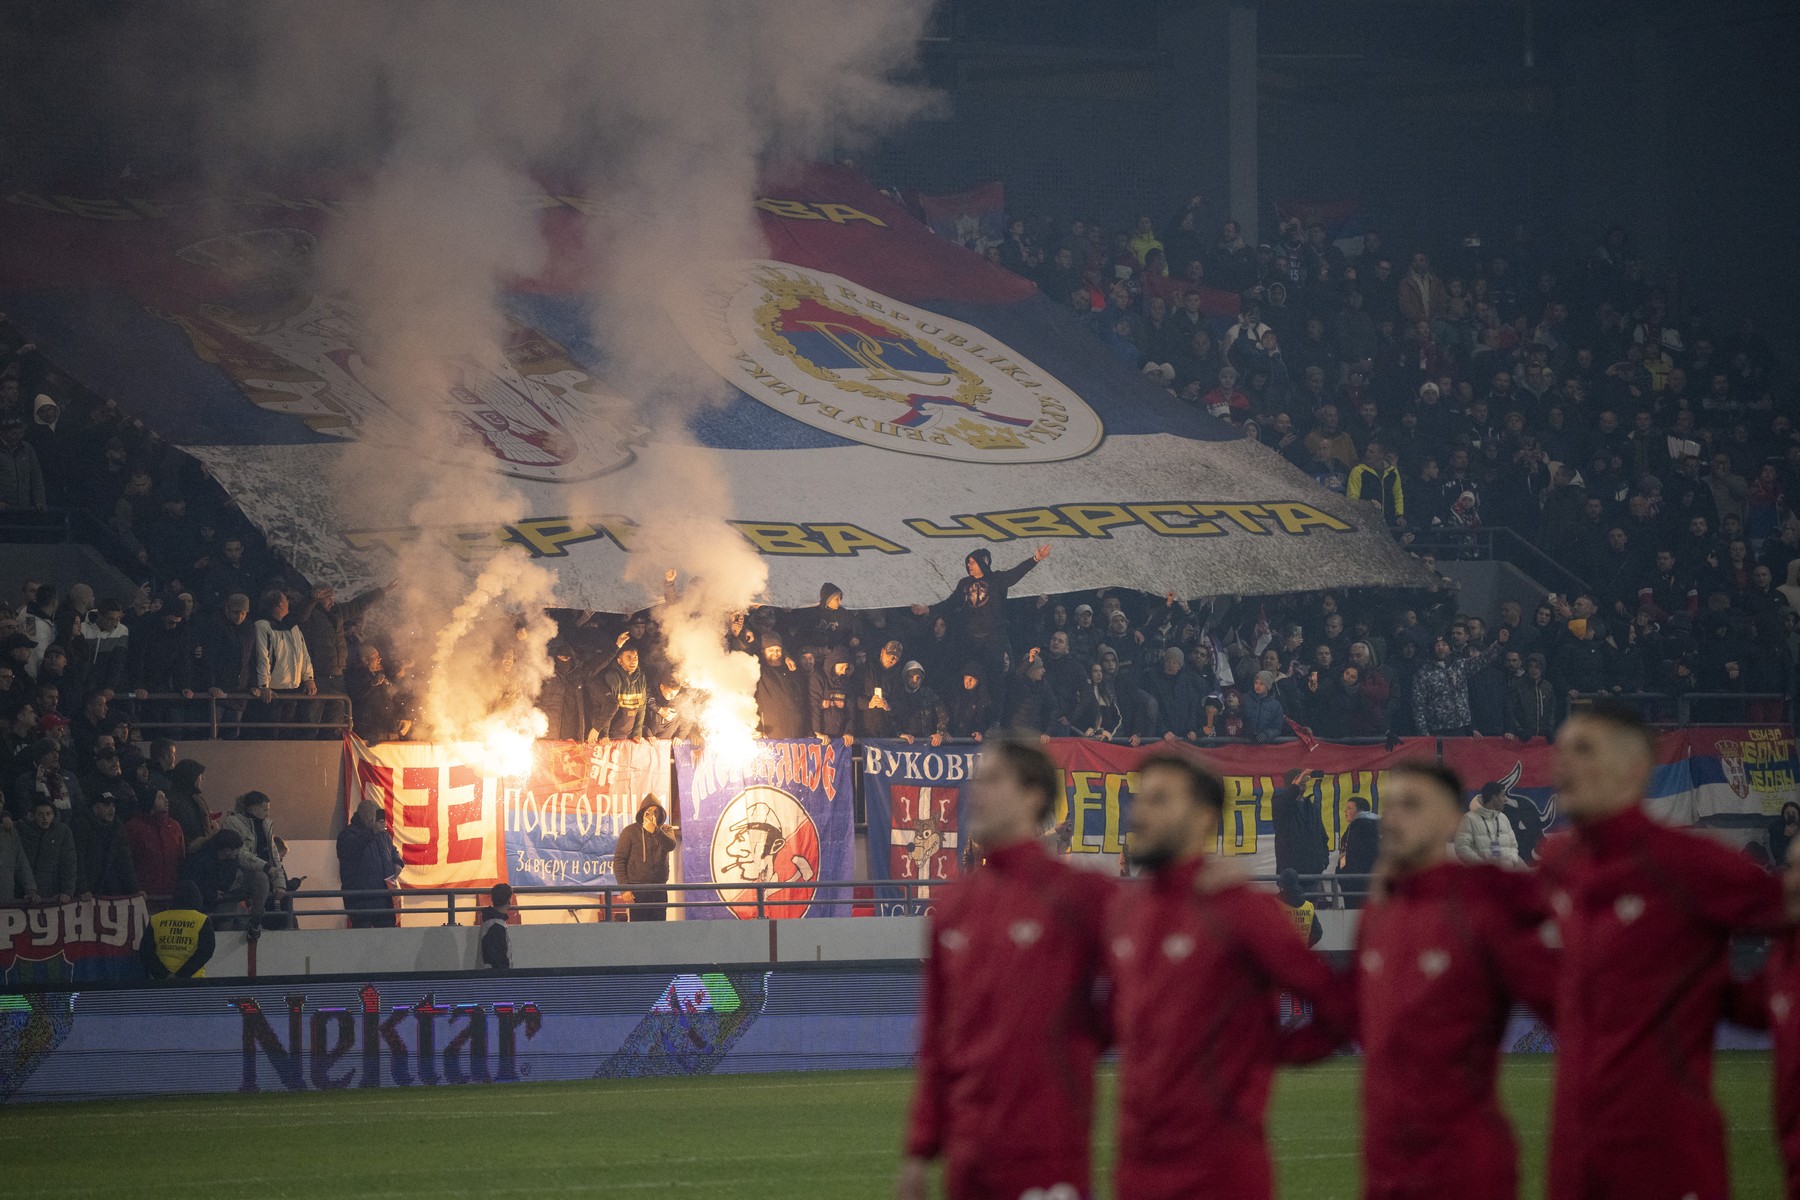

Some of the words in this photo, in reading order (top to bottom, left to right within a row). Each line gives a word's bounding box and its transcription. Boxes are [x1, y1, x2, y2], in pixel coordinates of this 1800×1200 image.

[731, 350, 953, 446] РЕПУБЛИКА
[834, 283, 1040, 388] REPUBLIKA
[1026, 394, 1070, 445] SRPSKA
[904, 500, 1358, 543] ЧВРСТА
[583, 859, 615, 875] отач
[226, 983, 543, 1093] Nektar
